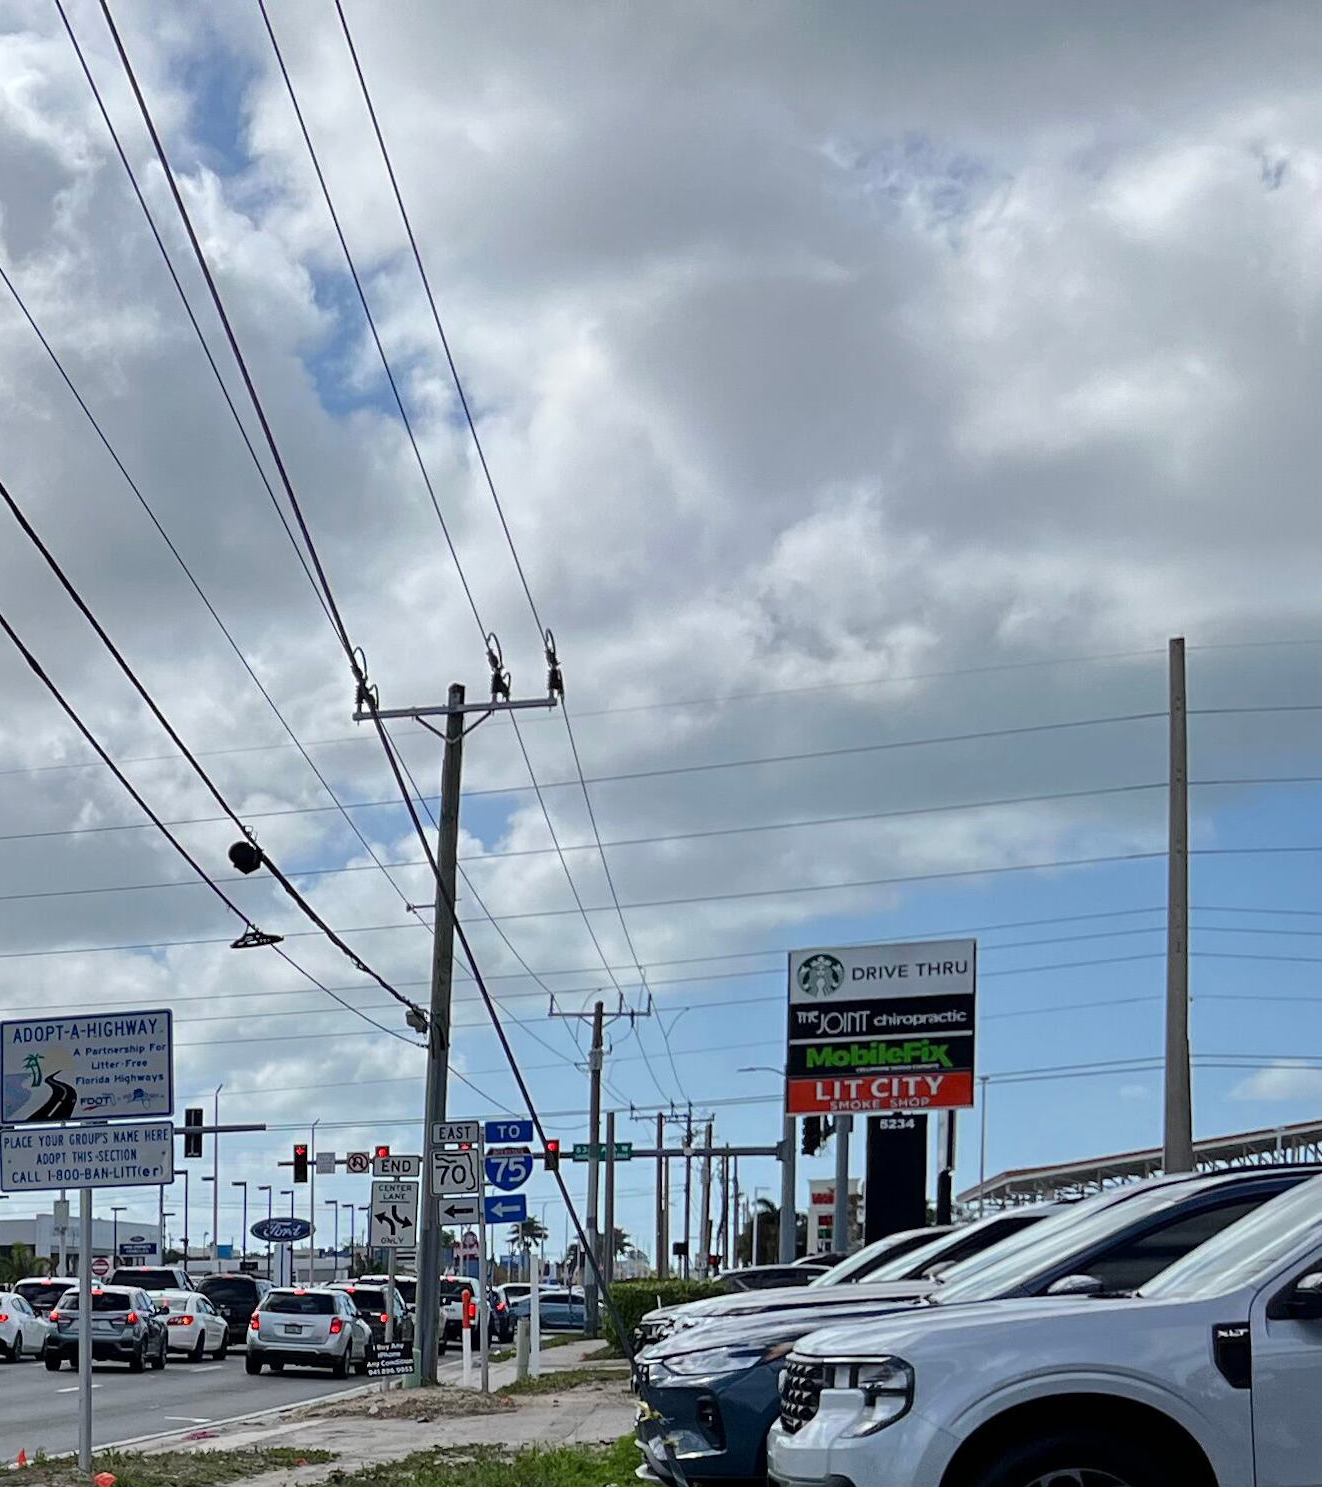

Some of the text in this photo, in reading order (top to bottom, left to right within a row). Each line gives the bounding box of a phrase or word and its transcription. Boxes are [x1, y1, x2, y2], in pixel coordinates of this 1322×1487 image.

[851, 960, 969, 981] DRIVE THRU
[816, 1010, 871, 1035] JOINT
[873, 1009, 967, 1027] chiropractic
[12, 1018, 158, 1044] ADOPT-A-HIGHWAY
[73, 1043, 166, 1056] A Partnership For
[806, 1039, 954, 1068] MobileFix
[91, 1058, 148, 1070] Litter-Free
[76, 1073, 164, 1085] Florida Highways
[815, 1075, 945, 1101] LIT CITY
[80, 1096, 110, 1105] FDOT
[830, 1096, 930, 1111] SMOKE SHOP
[3, 1128, 169, 1149] PLACE YOUR GROUP'S NAME HERE
[439, 1126, 470, 1140] EAST
[497, 1125, 520, 1139] TO
[36, 1149, 137, 1165] ADOPT THIS SECTION
[381, 1160, 411, 1172] END
[490, 1157, 526, 1183] 75
[12, 1171, 41, 1183] CALL
[436, 1165, 466, 1185] 70
[378, 1184, 412, 1192] CENTER
[263, 1221, 301, 1237] Ford
